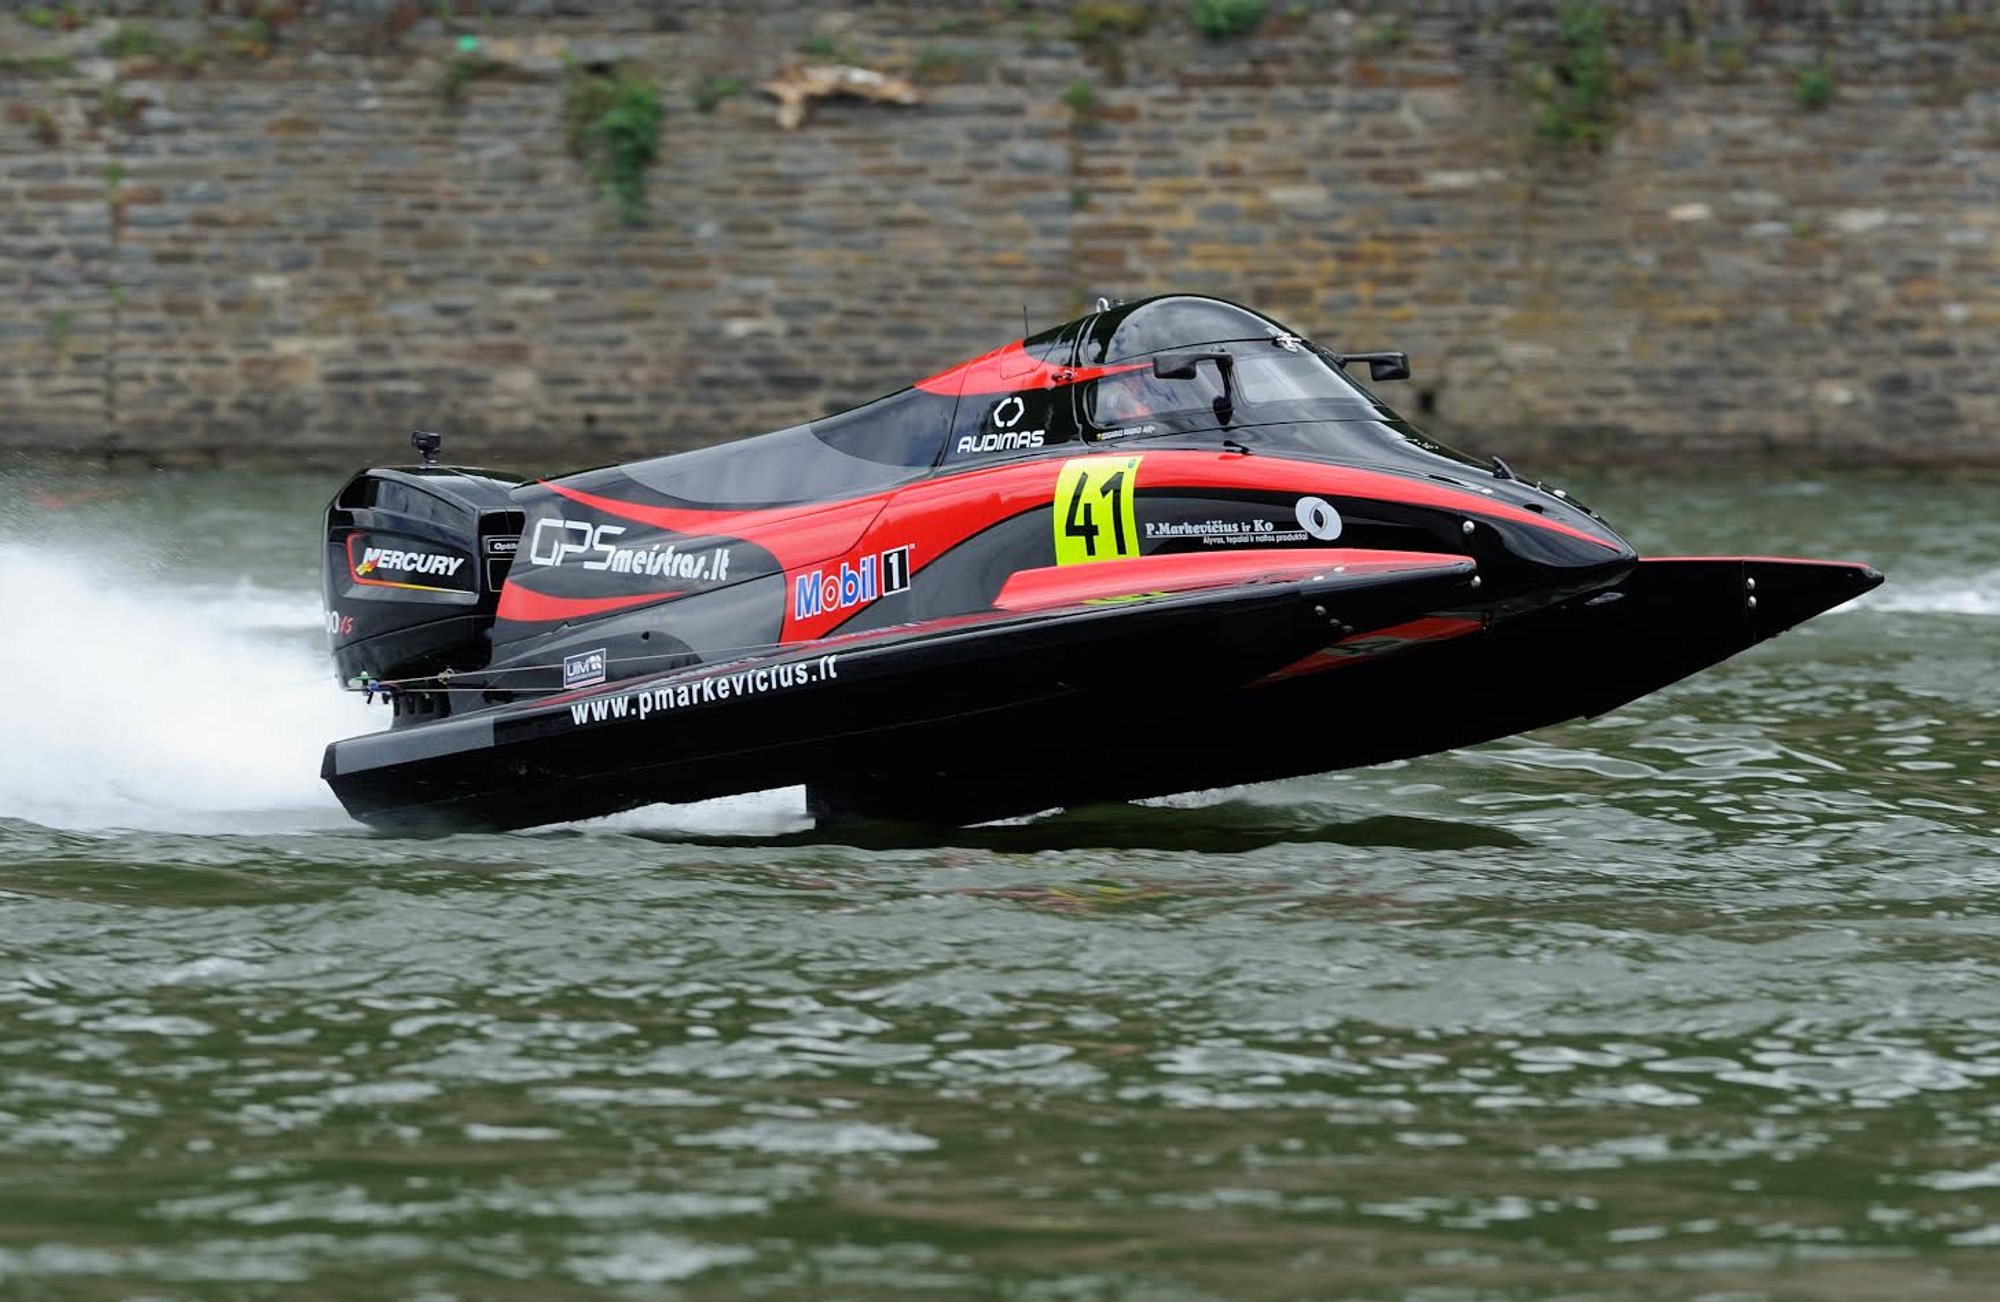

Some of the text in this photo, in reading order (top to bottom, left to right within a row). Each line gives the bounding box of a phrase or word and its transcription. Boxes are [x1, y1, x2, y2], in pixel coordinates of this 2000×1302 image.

[957, 430, 1045, 453] AUDIMAS
[1065, 471, 1127, 556] 41
[1241, 522, 1251, 533] ir
[1253, 519, 1274, 532] Ko
[357, 547, 464, 576] MERCURY
[795, 553, 877, 621] Mobil
[571, 655, 837, 725] www.pmarkevicius.lt
